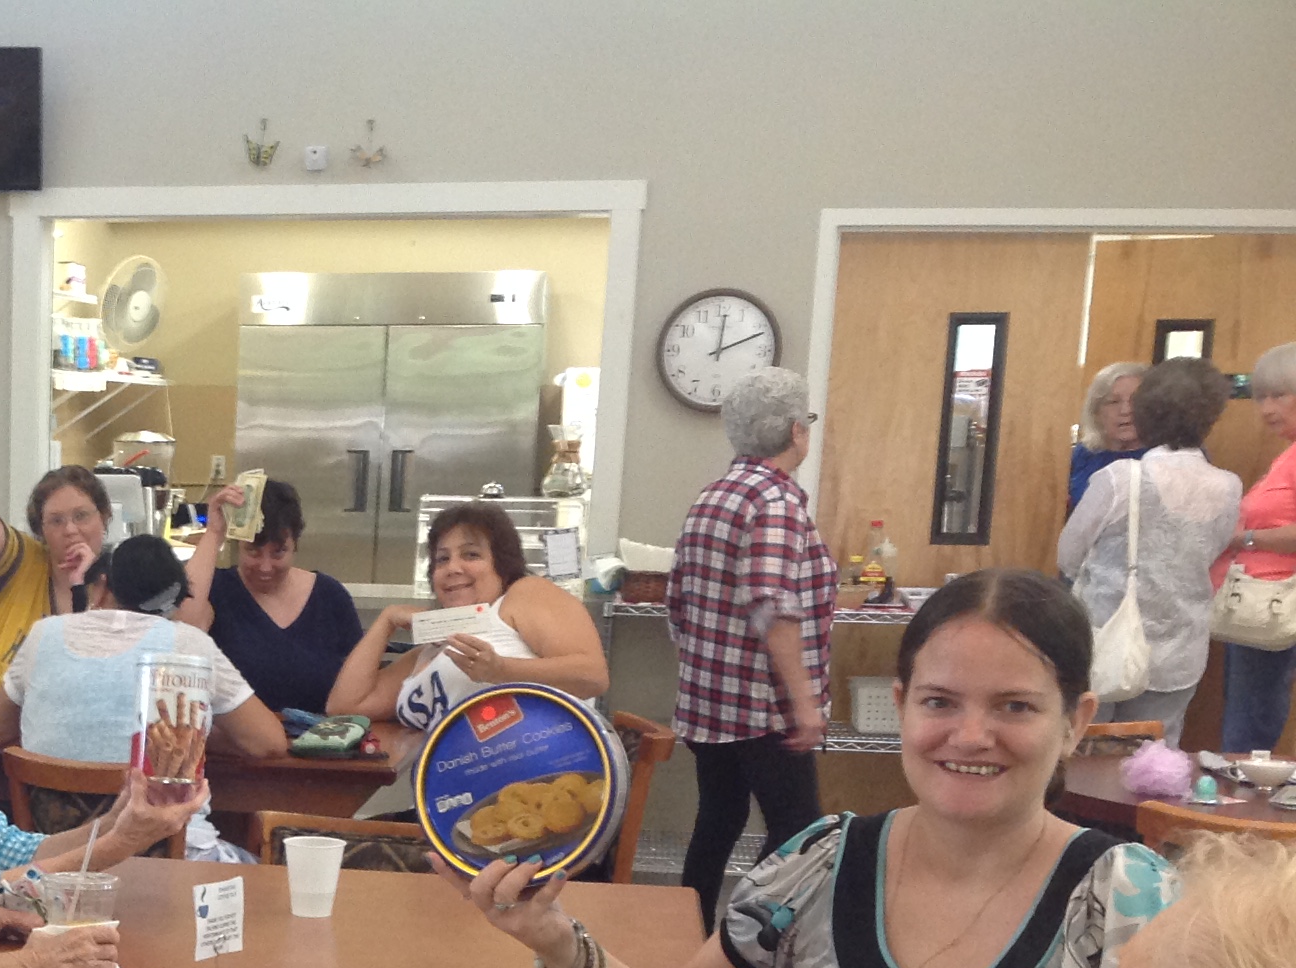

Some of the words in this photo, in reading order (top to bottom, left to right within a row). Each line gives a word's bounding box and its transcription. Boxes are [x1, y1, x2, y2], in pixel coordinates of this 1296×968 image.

[697, 310, 709, 324] 11
[680, 324, 695, 338] 10
[711, 383, 721, 397] 6
[476, 708, 517, 735] Benton's
[436, 751, 478, 773] Danish
[481, 739, 517, 759] Butter
[522, 722, 574, 745] Cookies
[464, 764, 488, 776] made
[491, 757, 507, 768] with
